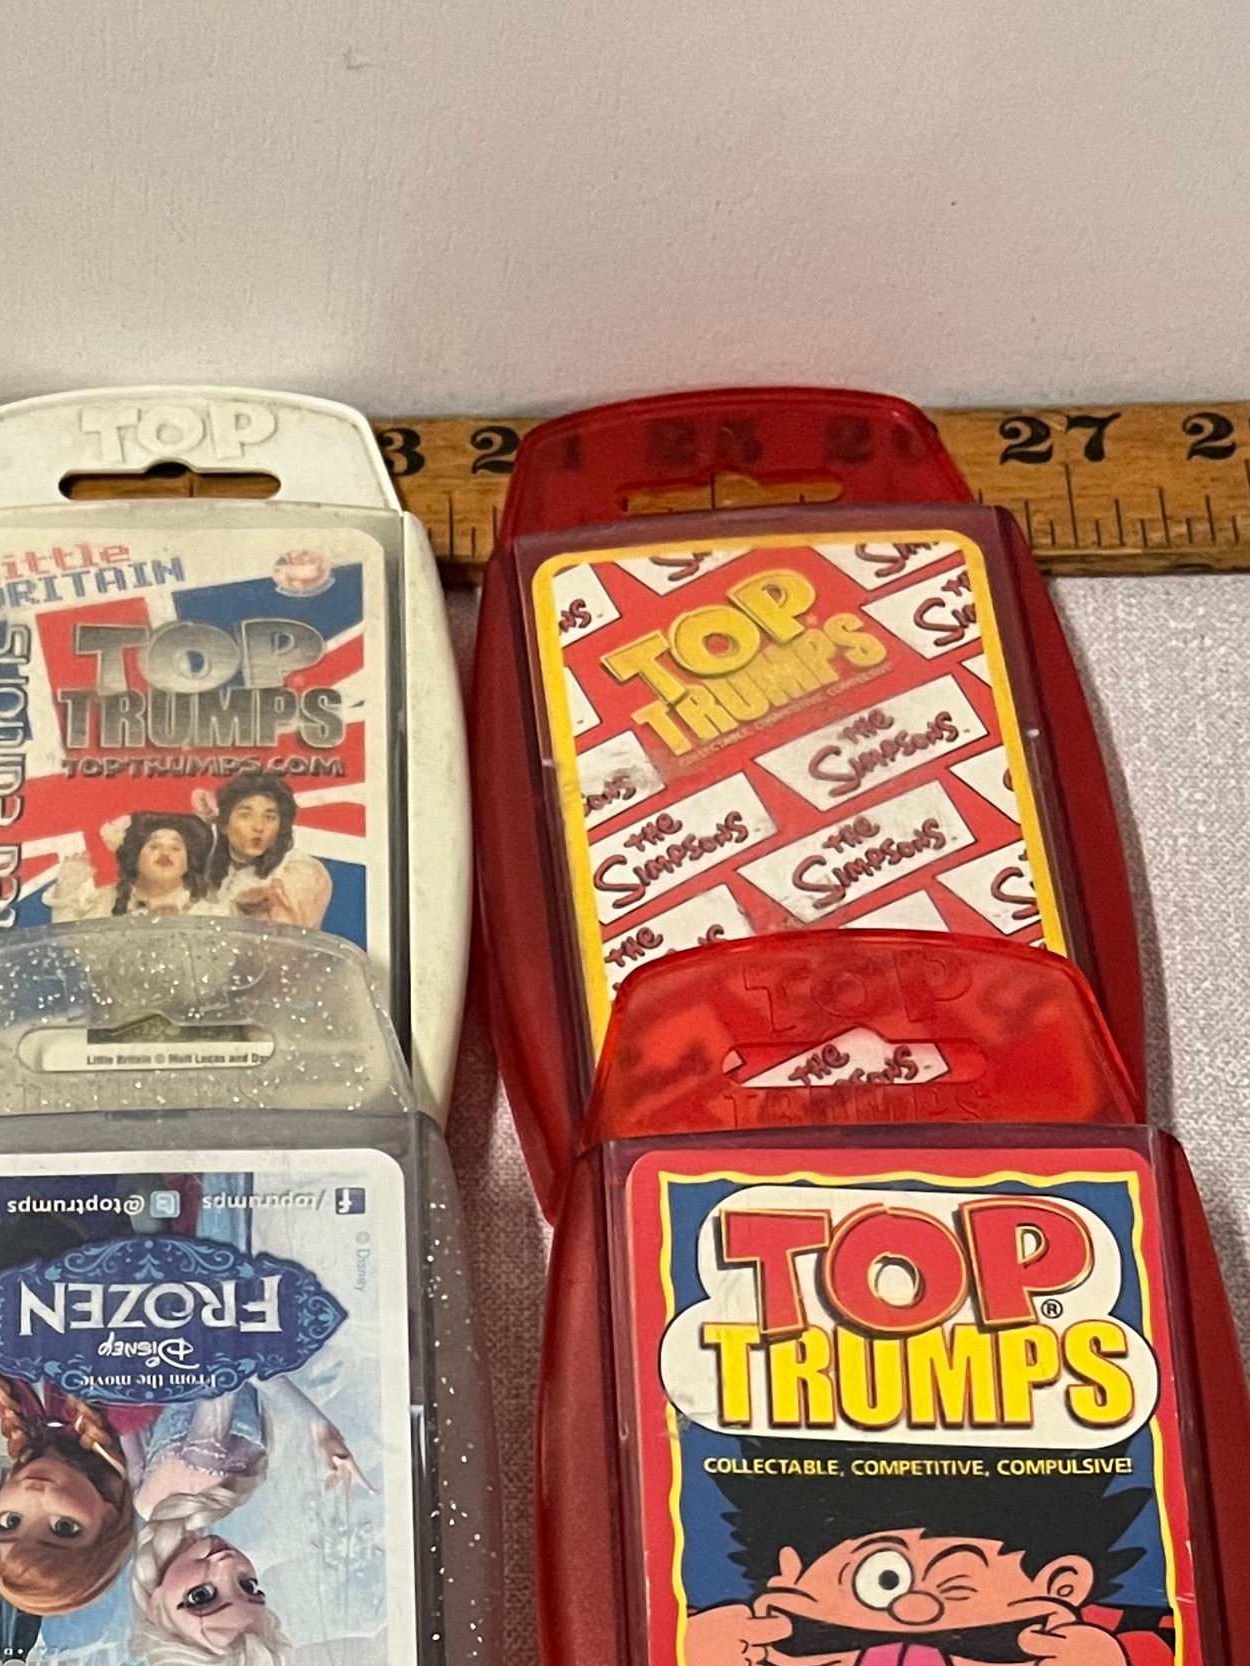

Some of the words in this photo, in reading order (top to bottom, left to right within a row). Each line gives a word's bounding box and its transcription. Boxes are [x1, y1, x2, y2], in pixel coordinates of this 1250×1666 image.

[81, 402, 278, 465] TOP
[999, 412, 1121, 465] 27
[1182, 411, 1250, 462] 2
[73, 617, 326, 696] TOP
[600, 568, 817, 706] TOP
[630, 612, 888, 756] TRUMPS
[57, 686, 347, 750] TRUMPS
[194, 1053, 227, 1066] Lucas
[228, 1053, 249, 1066] and
[7, 1194, 146, 1216] @toptrumps
[354, 1248, 372, 1295] Disney
[718, 1198, 1094, 1334] TOP
[19, 1275, 284, 1336] FROZEN
[98, 1331, 200, 1368] Disney
[702, 1320, 1136, 1428] TRUMPS
[79, 1374, 132, 1390] movie
[136, 1374, 163, 1389] the
[703, 1456, 845, 1477] COLLECTABLE,
[851, 1458, 990, 1477] COMPETITIVE,
[996, 1456, 1133, 1475] COMPULSIVE!
